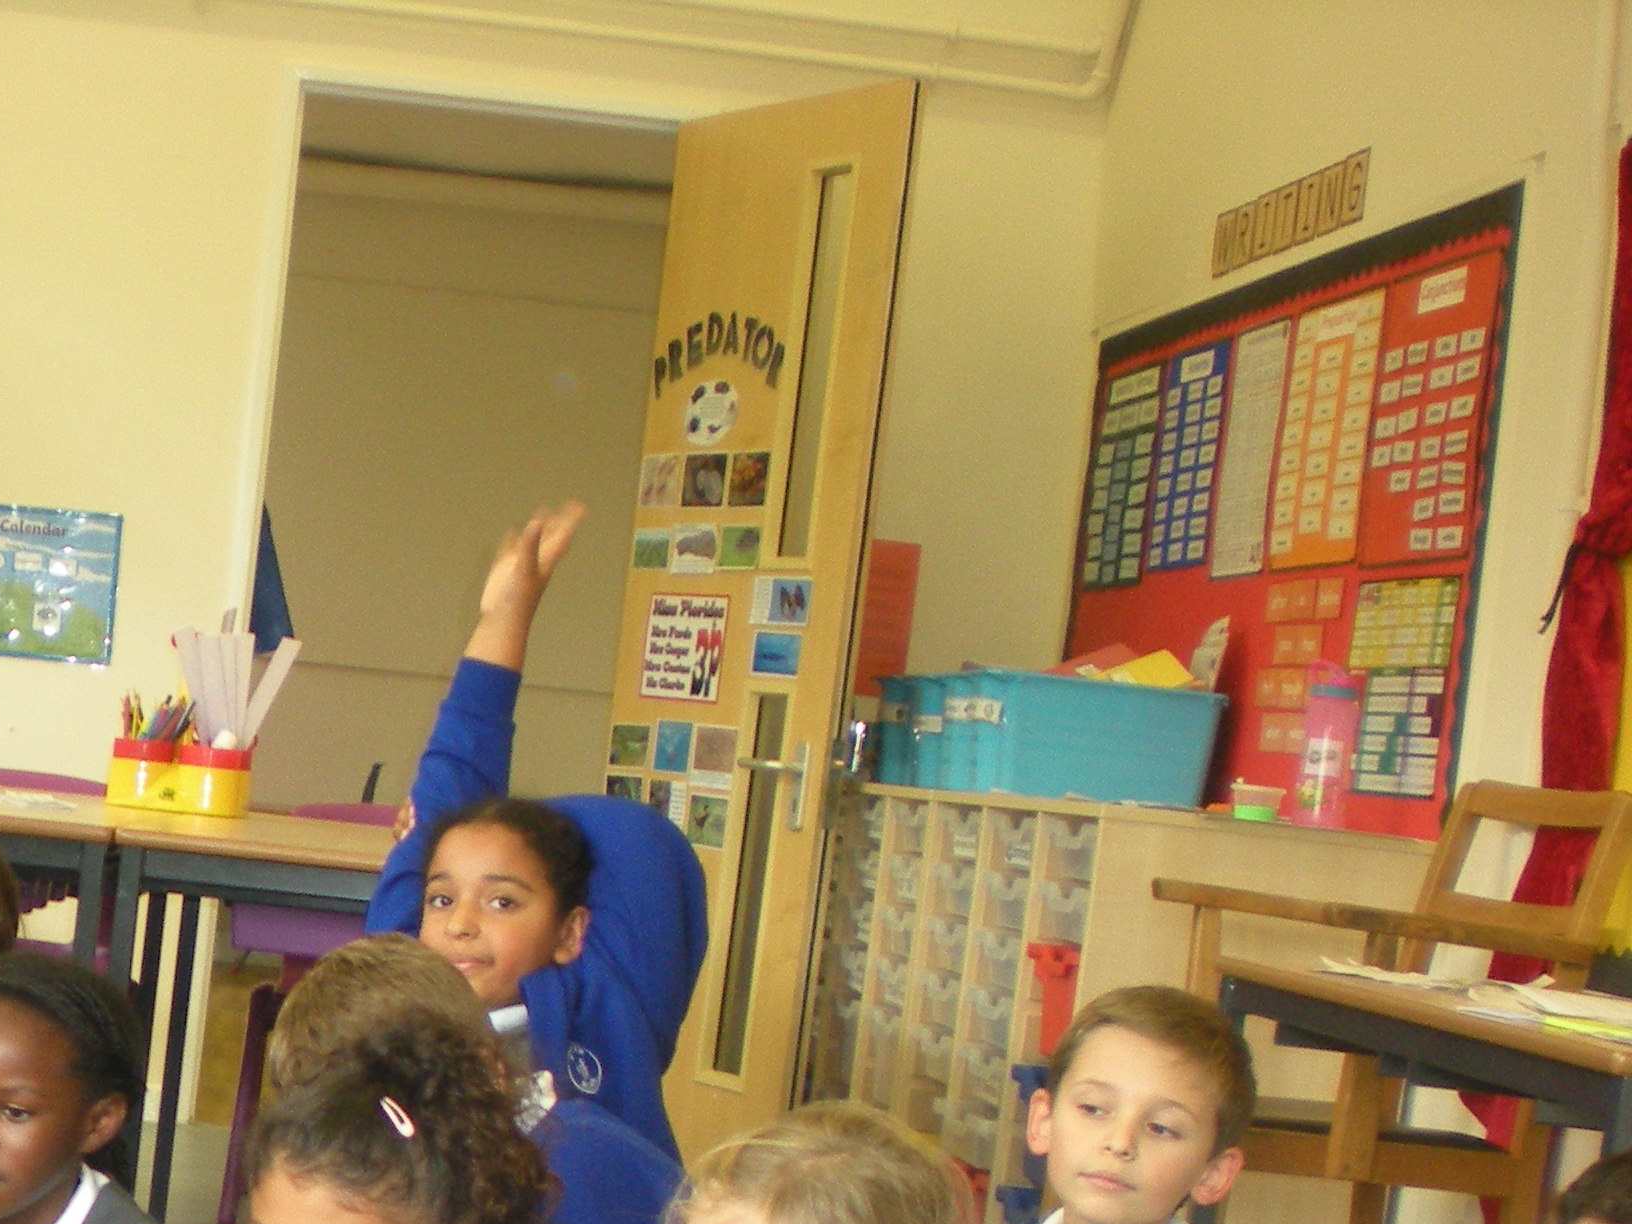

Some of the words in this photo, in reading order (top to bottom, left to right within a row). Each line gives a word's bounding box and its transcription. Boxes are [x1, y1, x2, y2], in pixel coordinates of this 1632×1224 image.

[1216, 160, 1365, 268] WRITING
[653, 310, 787, 400] PREDATOR
[0, 519, 68, 537] Calendar
